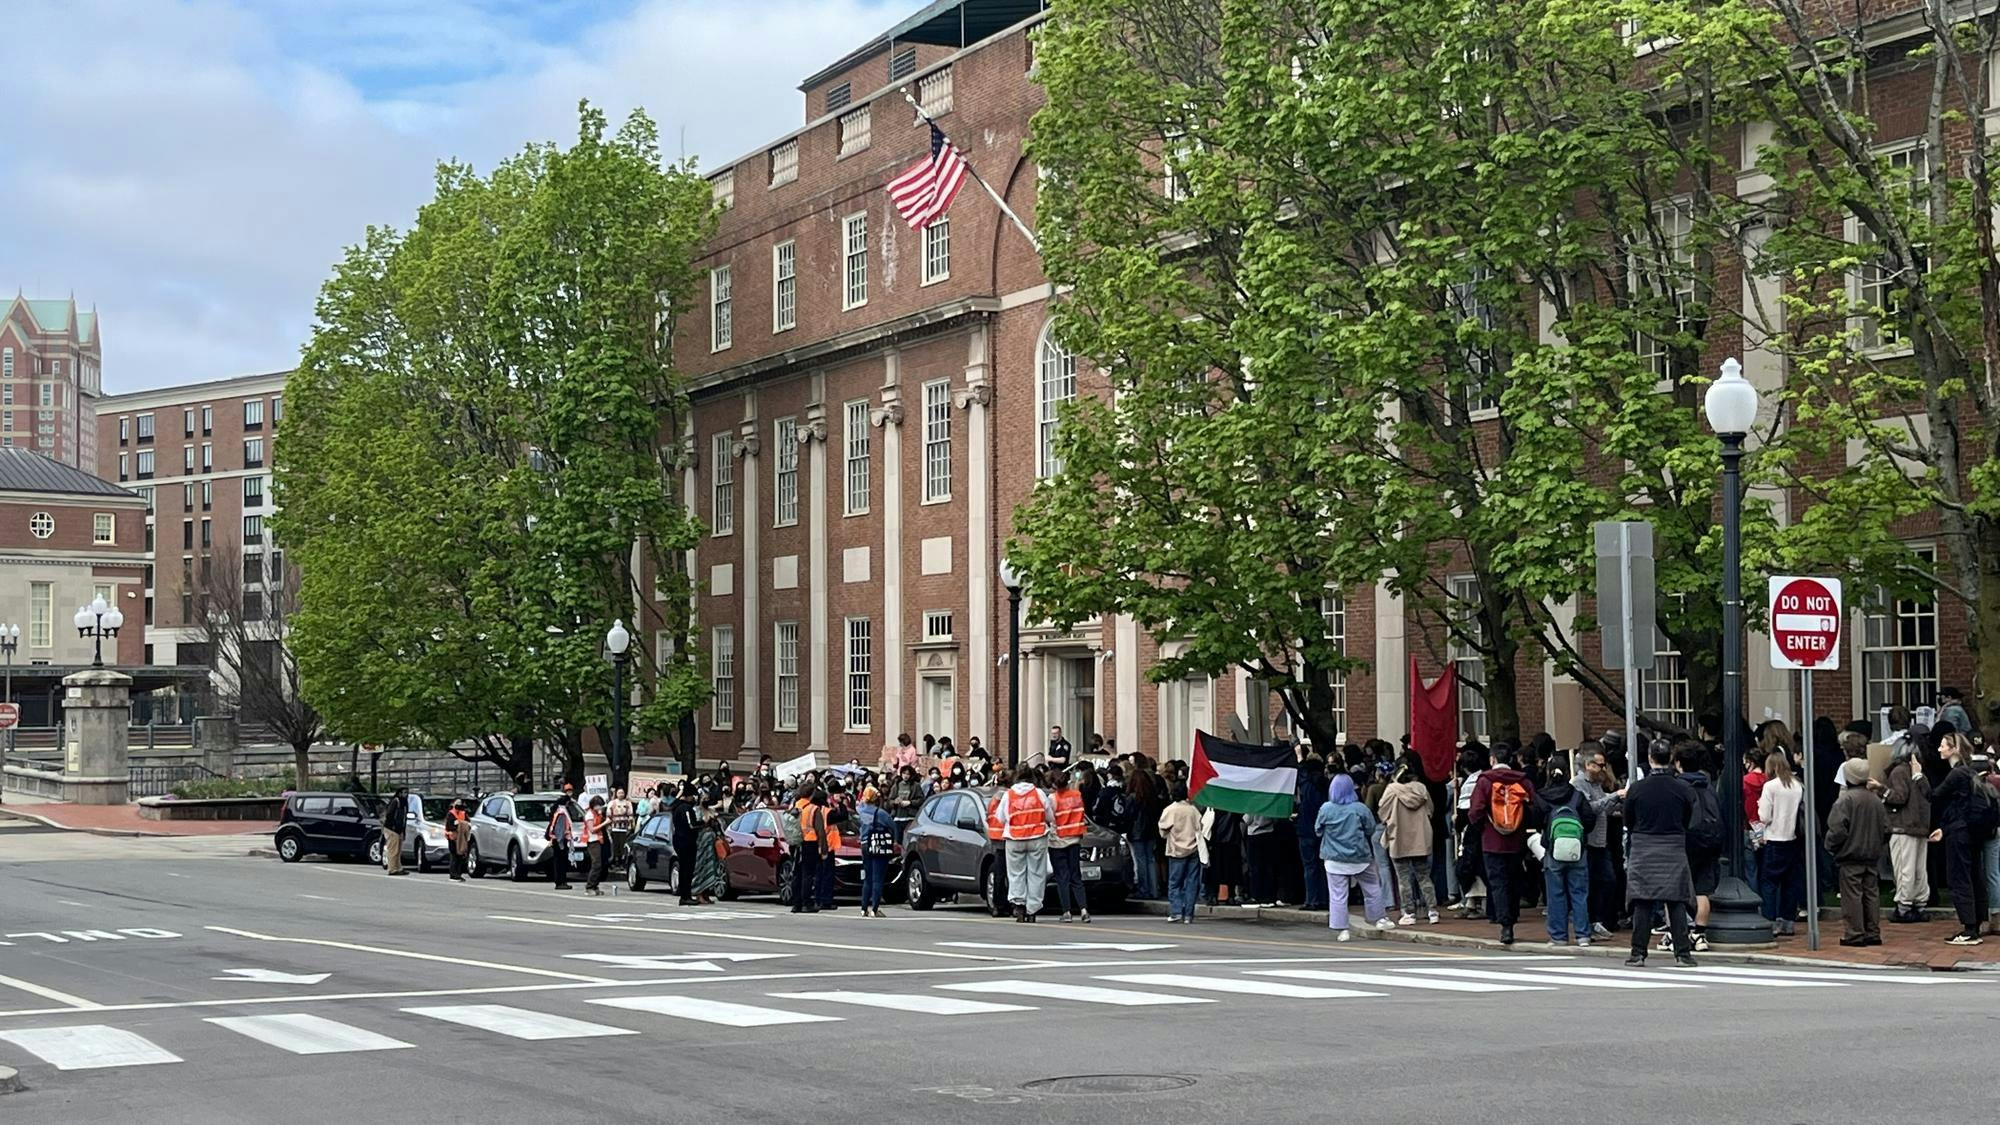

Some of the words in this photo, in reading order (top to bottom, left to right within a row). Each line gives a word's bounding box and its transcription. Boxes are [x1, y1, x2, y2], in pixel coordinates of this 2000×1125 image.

[1781, 595, 1799, 610] DO
[1806, 596, 1831, 611] NOT
[1786, 635, 1826, 650] ENTER
[0, 927, 183, 946] ONL
